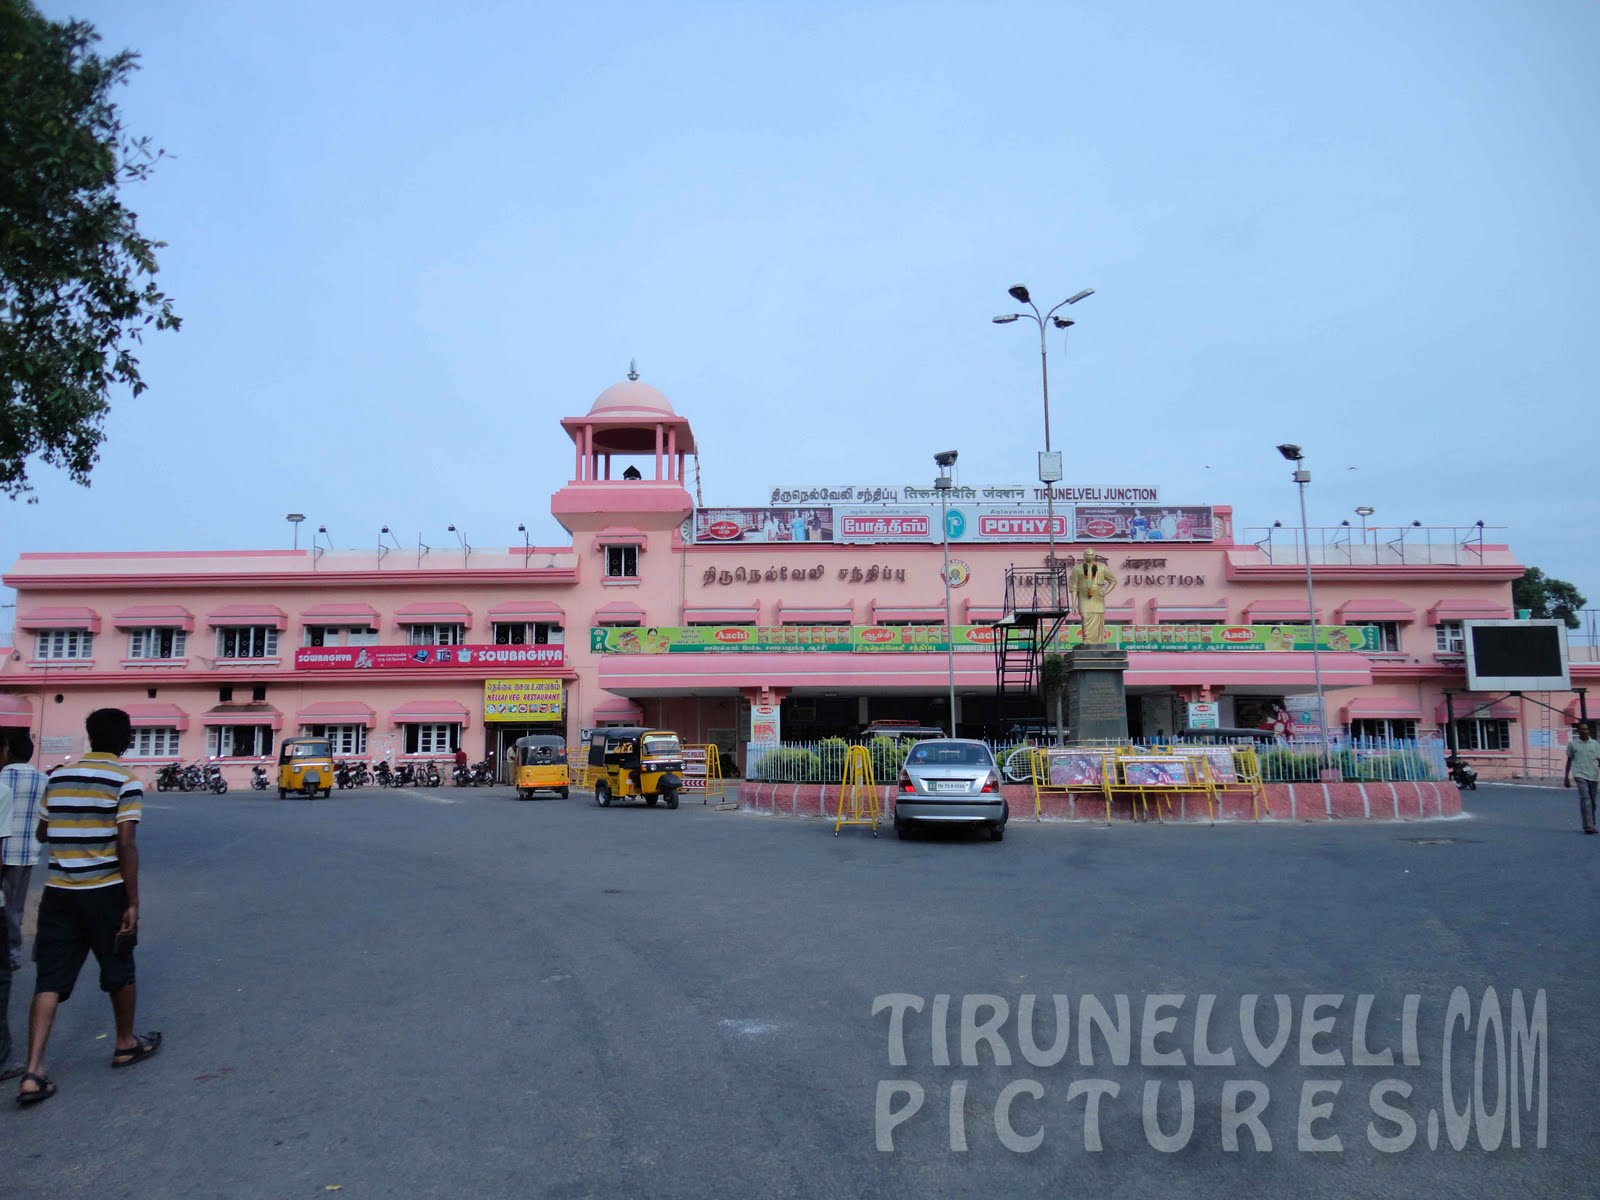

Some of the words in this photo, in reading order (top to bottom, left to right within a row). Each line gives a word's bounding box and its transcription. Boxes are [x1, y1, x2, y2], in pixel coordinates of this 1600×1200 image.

[771, 487, 854, 503] திருநெல்வேலி
[856, 488, 898, 503] சந்திப்பு
[1034, 488, 1101, 500] TIRUNELVELI
[1104, 488, 1157, 500] JUNCTION
[985, 519, 1061, 532] POTHYS
[703, 565, 825, 586] திருநெல்வேலி
[837, 565, 906, 585] சந்திப்பு
[1124, 575, 1206, 587] JUNCTION
[717, 630, 749, 640] Aachi
[1222, 631, 1255, 640] Aachi
[298, 654, 352, 662] SOWBAGHYA
[479, 649, 563, 661] SOWBAGHYA
[487, 694, 507, 702] NELLAI
[523, 693, 560, 701] RESTAURANT
